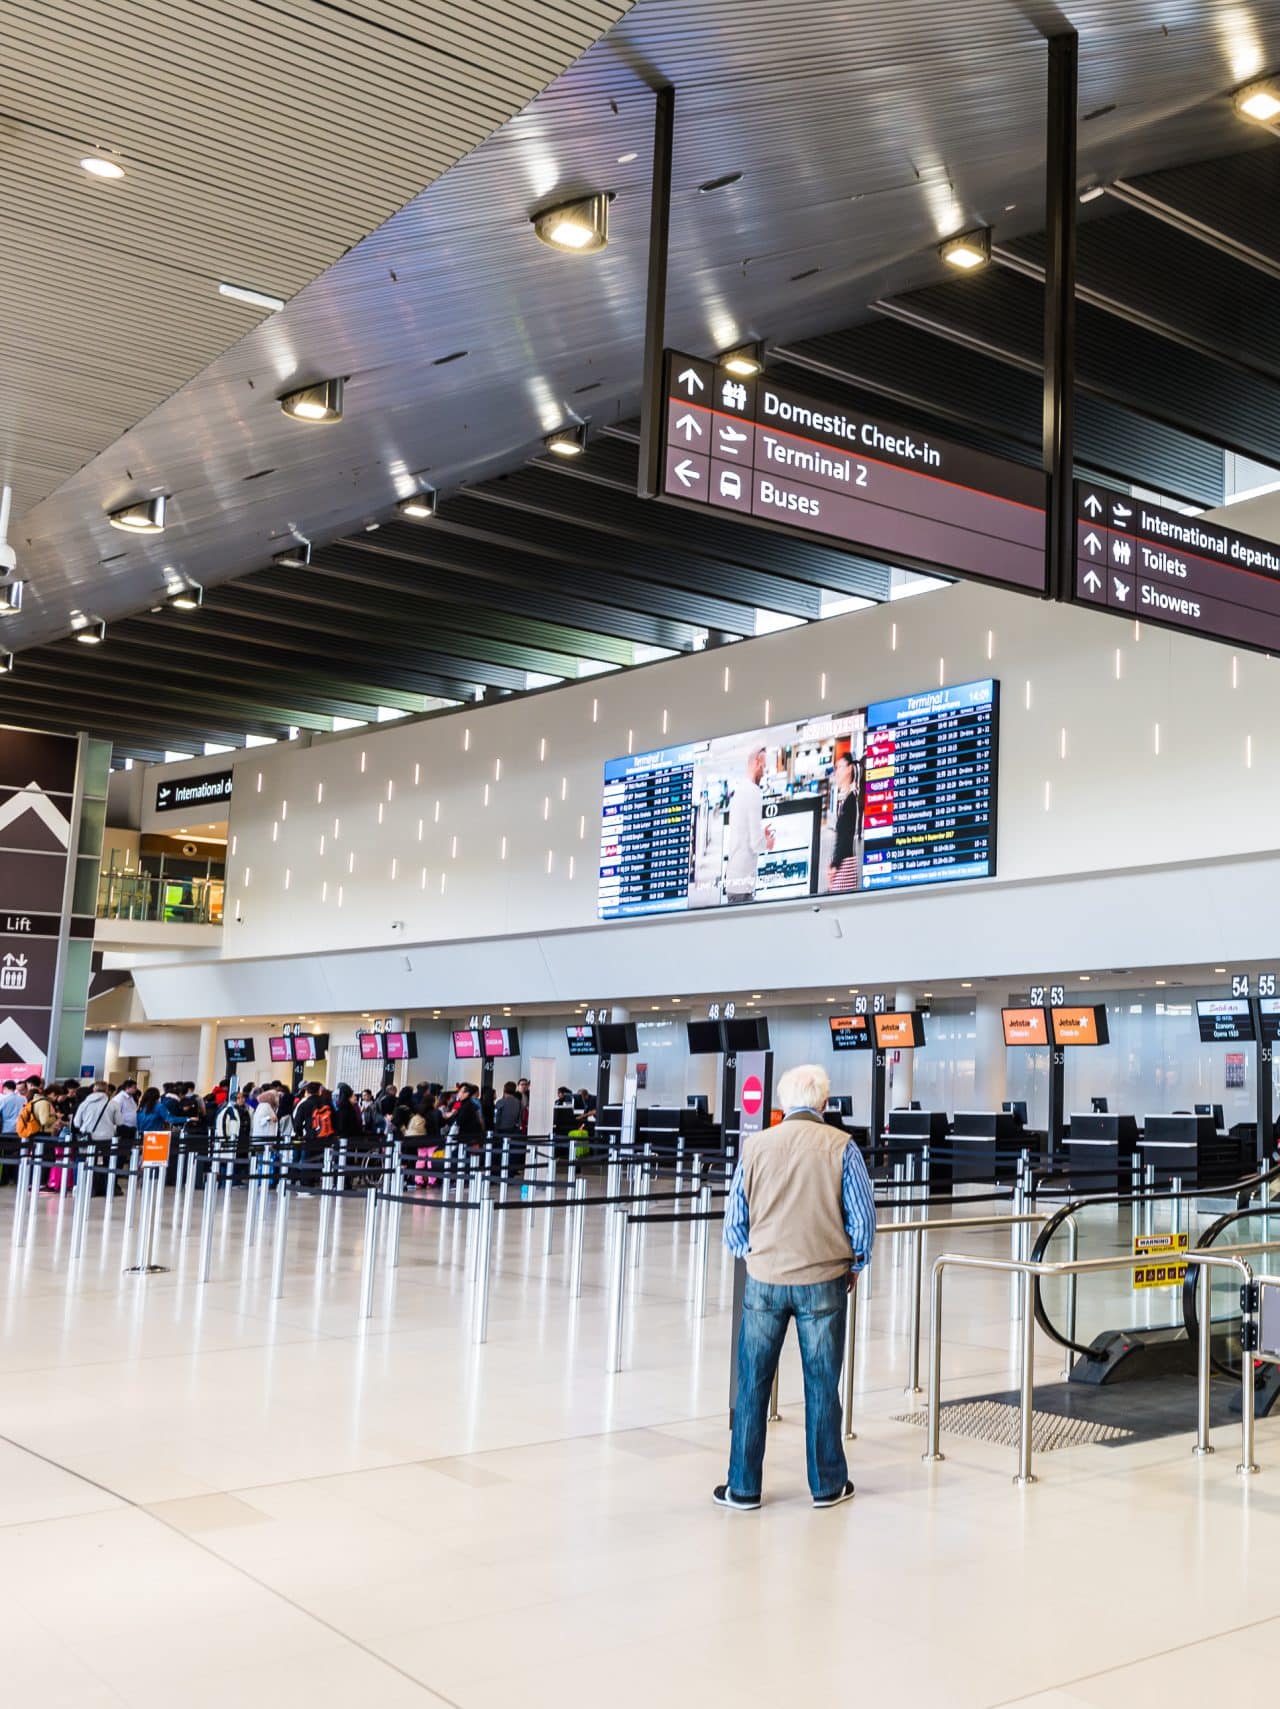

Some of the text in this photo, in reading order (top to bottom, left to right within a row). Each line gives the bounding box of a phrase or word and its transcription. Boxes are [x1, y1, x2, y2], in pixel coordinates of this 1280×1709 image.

[764, 392, 941, 467] Domestic Check-in
[763, 436, 868, 487] Terminal 2
[760, 480, 820, 516] Buses
[1141, 511, 1228, 555] International
[1142, 548, 1187, 578] Toilets
[1141, 585, 1201, 618] Showers
[908, 691, 941, 710] Terminal
[175, 777, 233, 801] International d
[7, 917, 32, 932] Lift
[1232, 976, 1249, 997] 54
[1259, 975, 1275, 995] 55
[873, 995, 885, 1012] 51
[1030, 988, 1044, 1006] 52
[1050, 987, 1064, 1005] 53
[708, 1004, 720, 1019] 48
[724, 1003, 735, 1019] 49
[855, 996, 867, 1014] 50
[469, 1016, 479, 1029] 44
[482, 1015, 491, 1028] 45
[585, 1009, 595, 1024] 46
[598, 1009, 608, 1024] 47
[726, 1058, 737, 1068] 49
[876, 1056, 886, 1066] 51
[1054, 1053, 1064, 1065] 53
[1261, 1048, 1272, 1061] 55
[600, 1059, 610, 1069] 47
